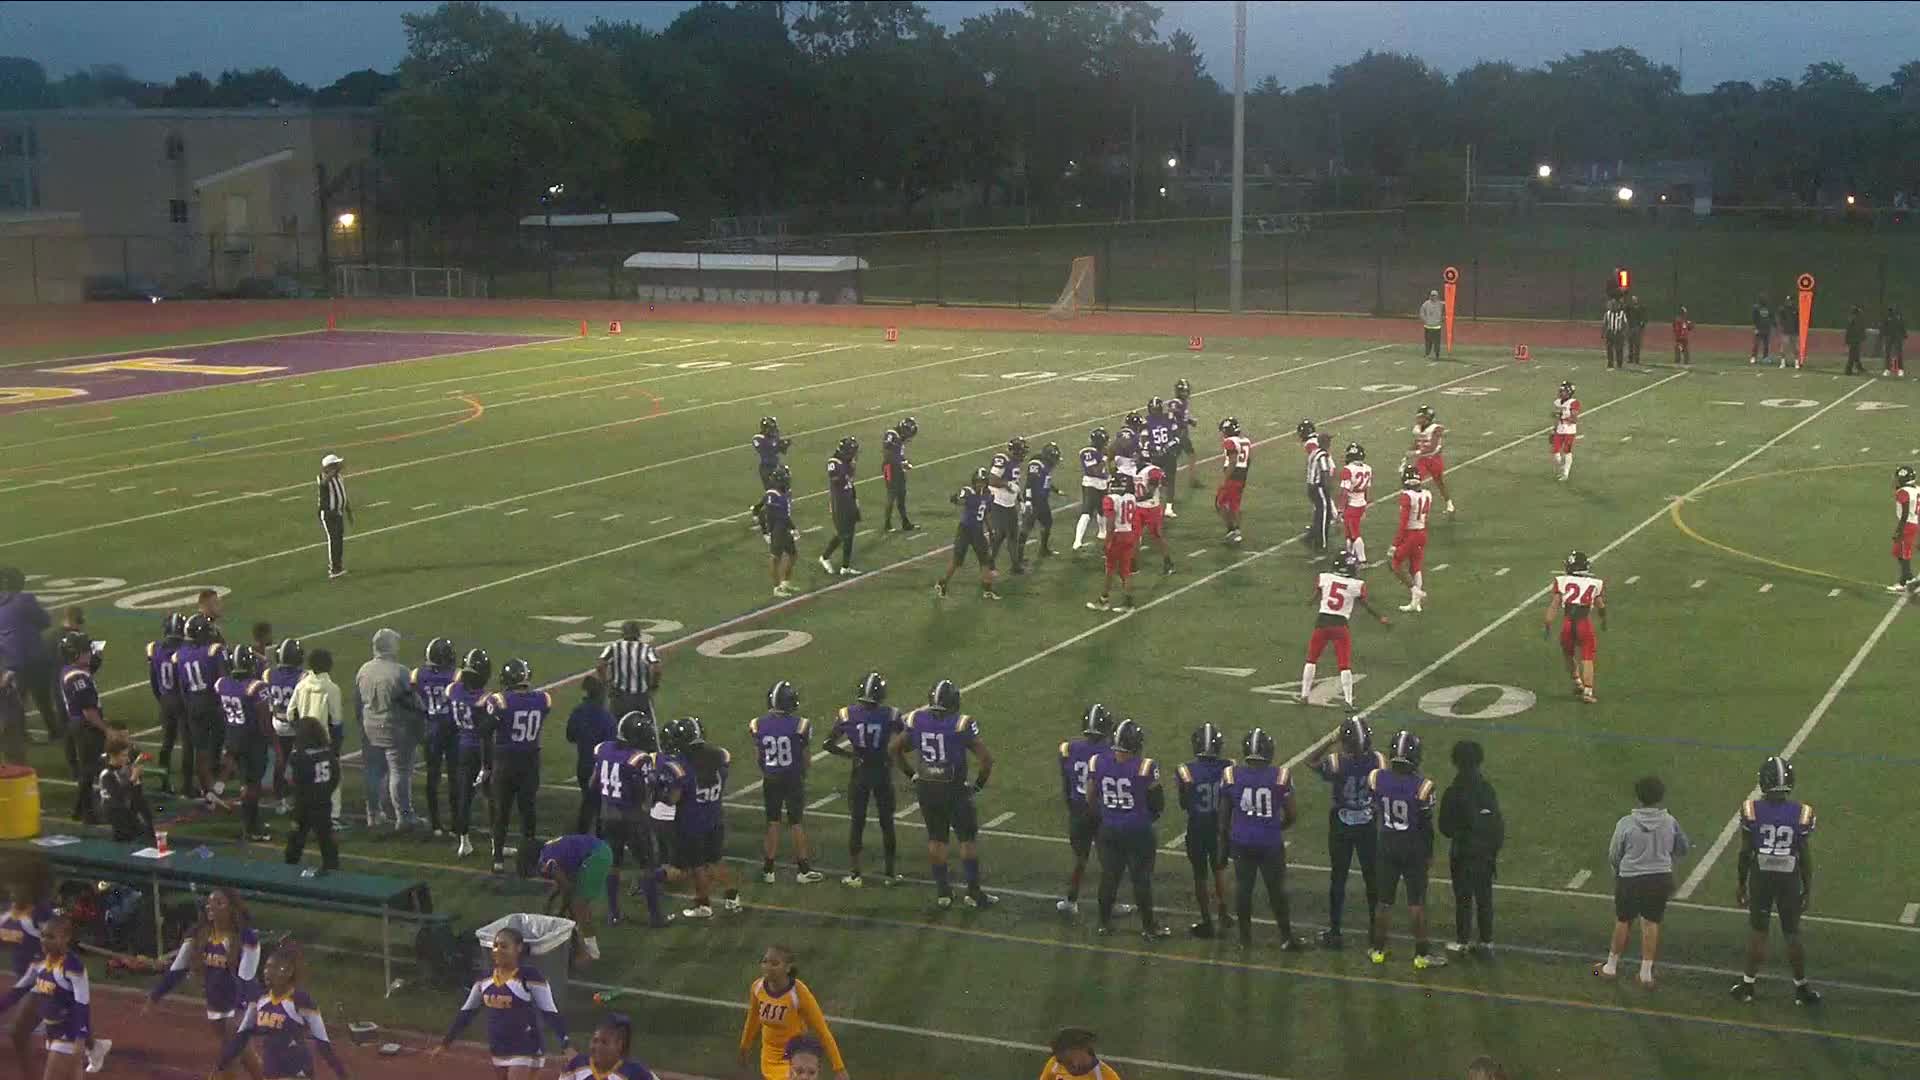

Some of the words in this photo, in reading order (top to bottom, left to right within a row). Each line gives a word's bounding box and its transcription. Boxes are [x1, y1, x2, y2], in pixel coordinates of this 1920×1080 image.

[1620, 271, 1628, 287] 1
[1151, 427, 1169, 444] 56
[1327, 581, 1348, 612] 5
[1564, 582, 1595, 607] 24
[161, 662, 175, 690] 0
[184, 660, 208, 692] 11
[511, 710, 541, 742] 50
[856, 722, 882, 750] 17
[762, 735, 793, 768] 28
[920, 732, 946, 764] 51
[600, 760, 622, 799] 44
[1074, 761, 1091, 795] 3
[1101, 776, 1136, 811] 66
[1240, 787, 1274, 819] 40
[1381, 796, 1410, 832] 19
[1758, 823, 1794, 856] 32
[756, 1001, 788, 1021] EAST
